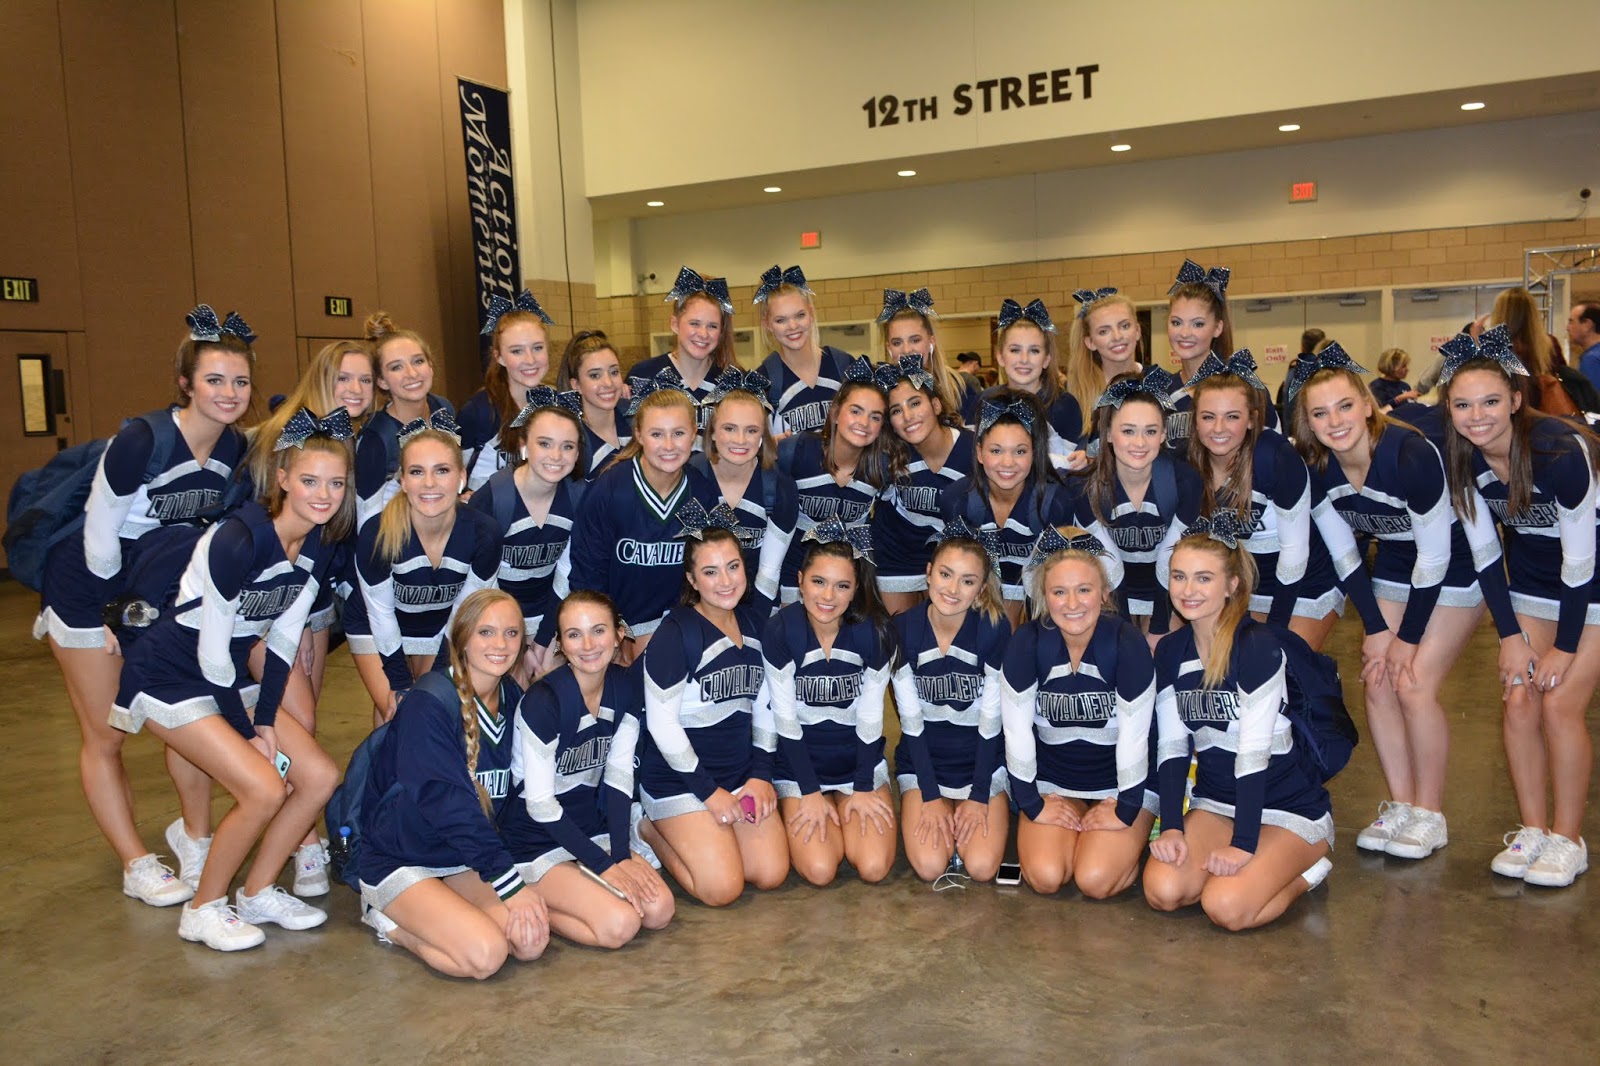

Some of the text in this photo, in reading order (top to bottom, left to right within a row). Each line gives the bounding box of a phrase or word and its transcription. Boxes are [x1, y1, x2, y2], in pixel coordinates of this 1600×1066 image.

[862, 64, 1099, 128] 12TH STREET
[3, 279, 31, 300] EXIT
[330, 298, 348, 316] EXIT
